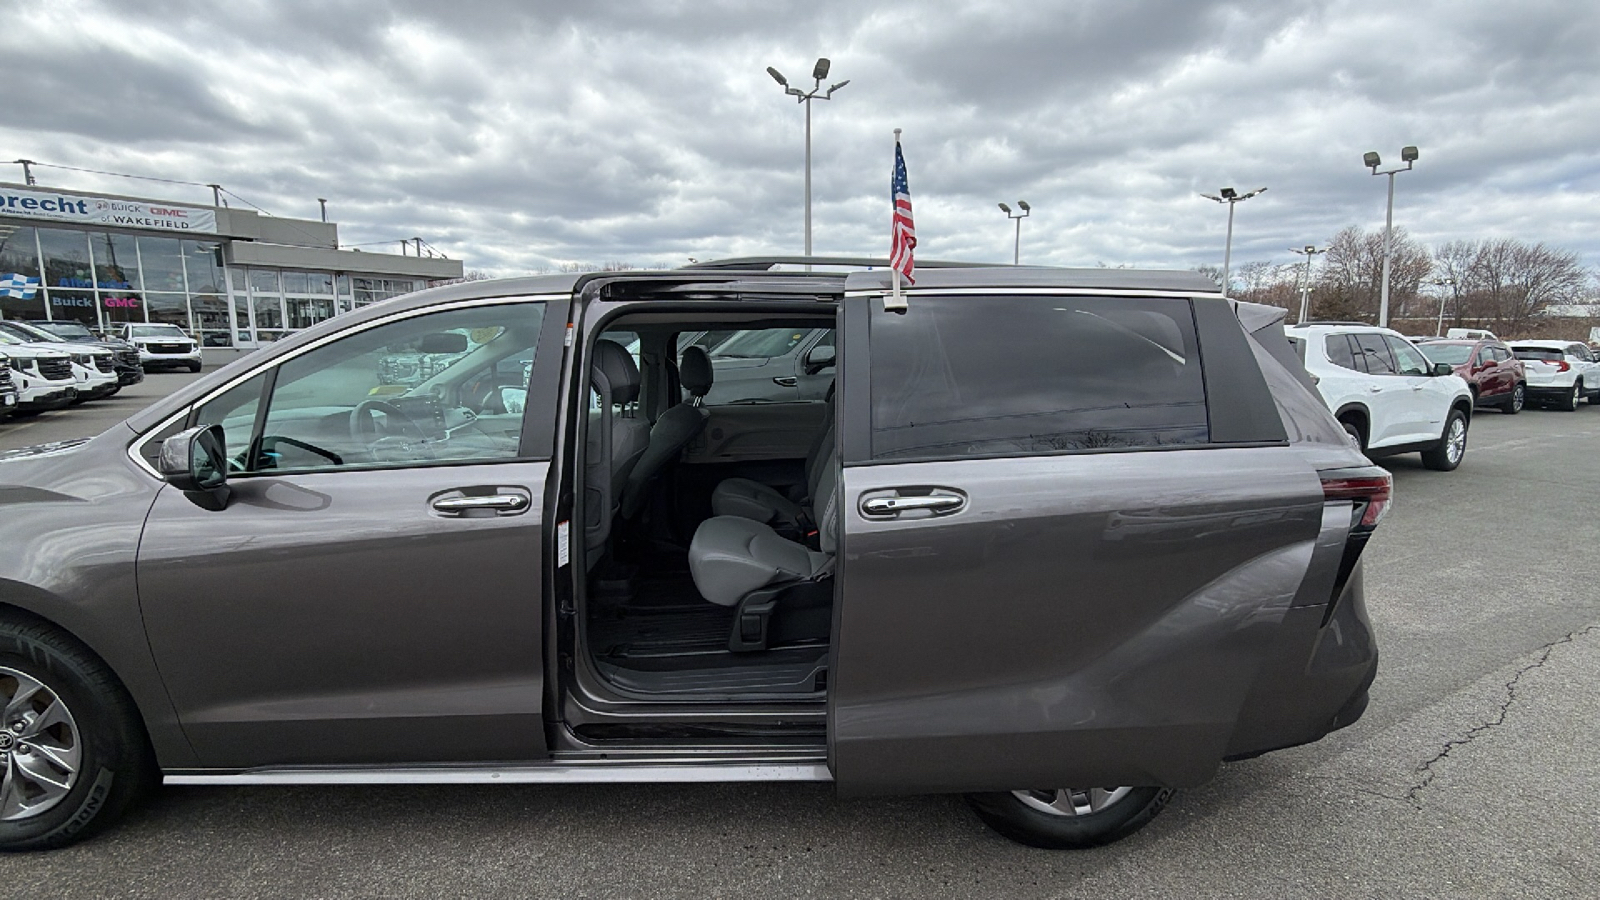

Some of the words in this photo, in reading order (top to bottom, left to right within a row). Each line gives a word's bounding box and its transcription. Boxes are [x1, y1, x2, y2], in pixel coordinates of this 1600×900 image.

[111, 202, 141, 213] BUICK
[150, 207, 188, 218] GMC
[113, 215, 189, 229] WAKEFIELD
[52, 296, 93, 307] Buick
[104, 297, 139, 308] GMC
